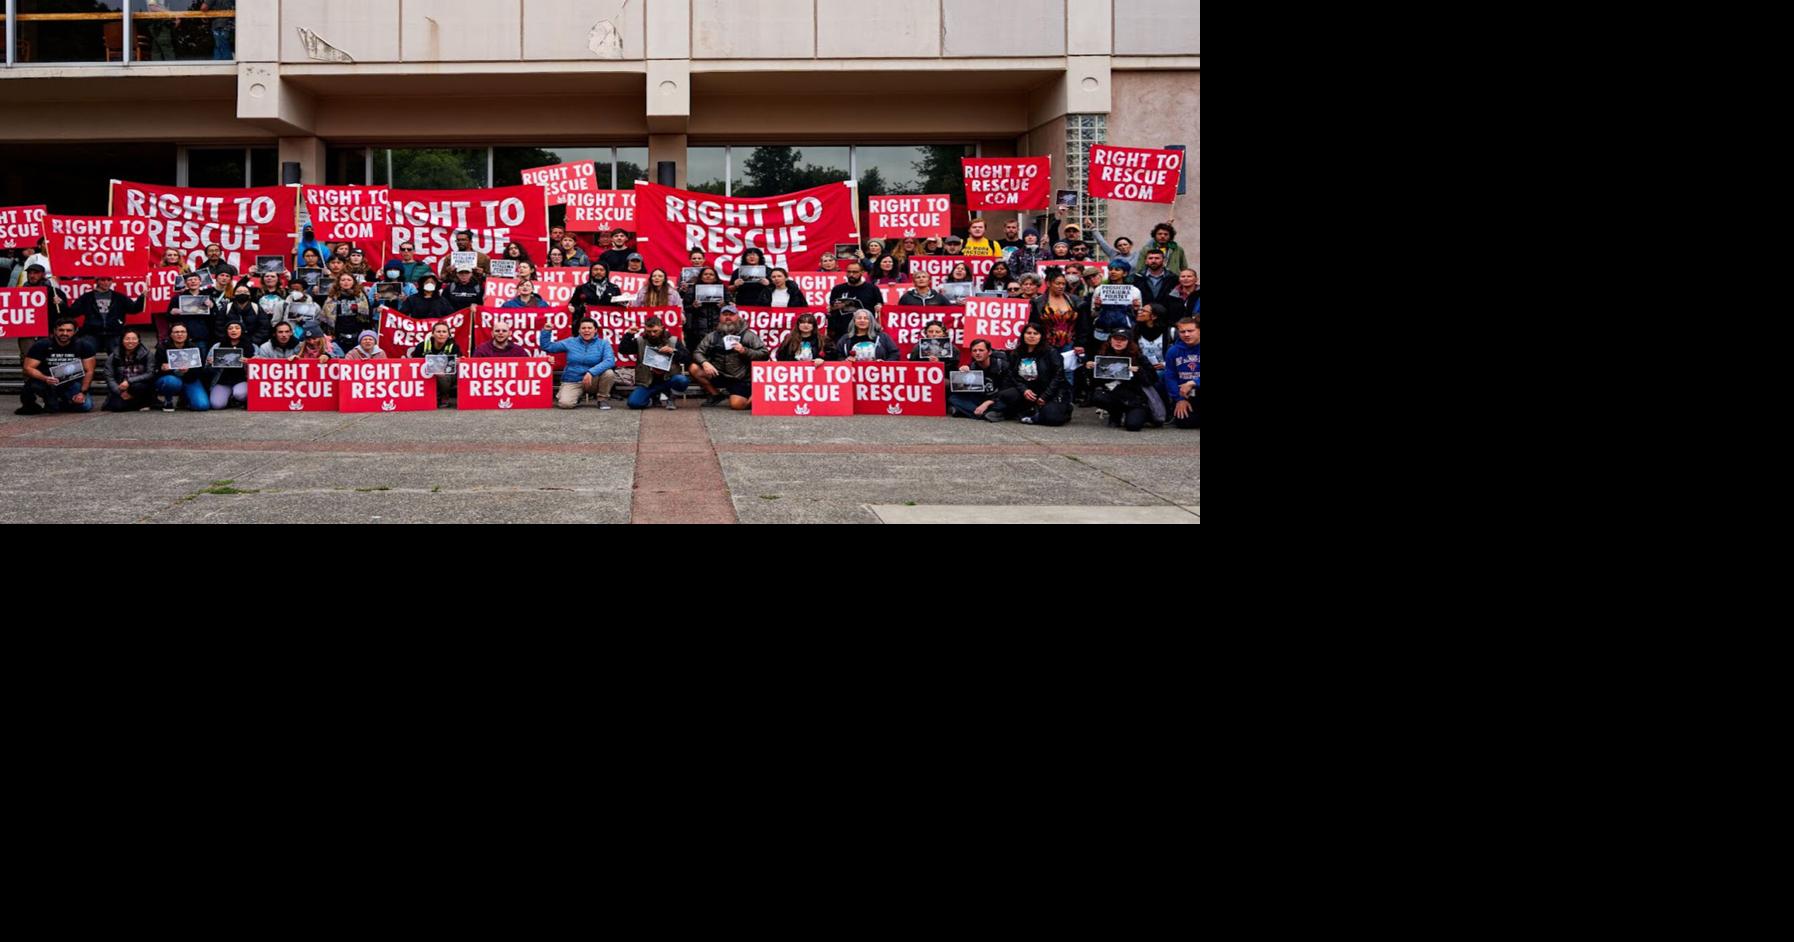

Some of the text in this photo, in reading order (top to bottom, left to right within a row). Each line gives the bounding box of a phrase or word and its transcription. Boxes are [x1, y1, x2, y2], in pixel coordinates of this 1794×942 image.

[1095, 149, 1179, 169] RIGHT TO
[522, 163, 594, 186] RIGHT TO
[964, 164, 1038, 179] RIGHT TO
[1101, 166, 1167, 185] RESCUE
[546, 178, 588, 196] ESCUE
[971, 178, 1030, 192] RESCUE
[1107, 183, 1153, 200] .COM
[307, 189, 389, 205] RIGHT TO
[567, 193, 615, 206] RIGHT
[869, 198, 950, 213] RIGHT TO
[127, 189, 276, 224] RIGHT TO
[318, 206, 383, 222] RESCUE
[480, 197, 525, 227] TO
[575, 208, 633, 221] RESCUE
[665, 195, 823, 227] RIGHT TO
[23, 209, 46, 223] TO
[879, 213, 940, 228] RESCUE
[52, 219, 145, 235] RIGHT TO
[148, 219, 260, 250] RESCUE
[328, 223, 373, 239] .COM
[64, 236, 135, 252] RESCUE
[686, 224, 807, 254] RESCUE
[74, 252, 125, 266] .COM
[971, 260, 994, 274] TO
[124, 281, 147, 298] TO
[547, 286, 571, 301] TO
[19, 291, 46, 307] TO
[966, 301, 1028, 319] RIGHT
[481, 312, 568, 330] RIGHT TO
[590, 310, 648, 328] RIGHT
[887, 312, 946, 328] RIGHT
[249, 363, 340, 380] RIGHT TO
[340, 364, 401, 381] RIGHT
[459, 361, 551, 379] RIGHT TO
[752, 366, 851, 384] RIGHT TO
[915, 366, 943, 385] TO
[259, 381, 333, 398] RESCUE
[352, 380, 424, 398] RESCUE
[469, 379, 540, 397] RESCUE
[764, 384, 840, 402] RESCUE
[857, 384, 932, 403] RESCUE
